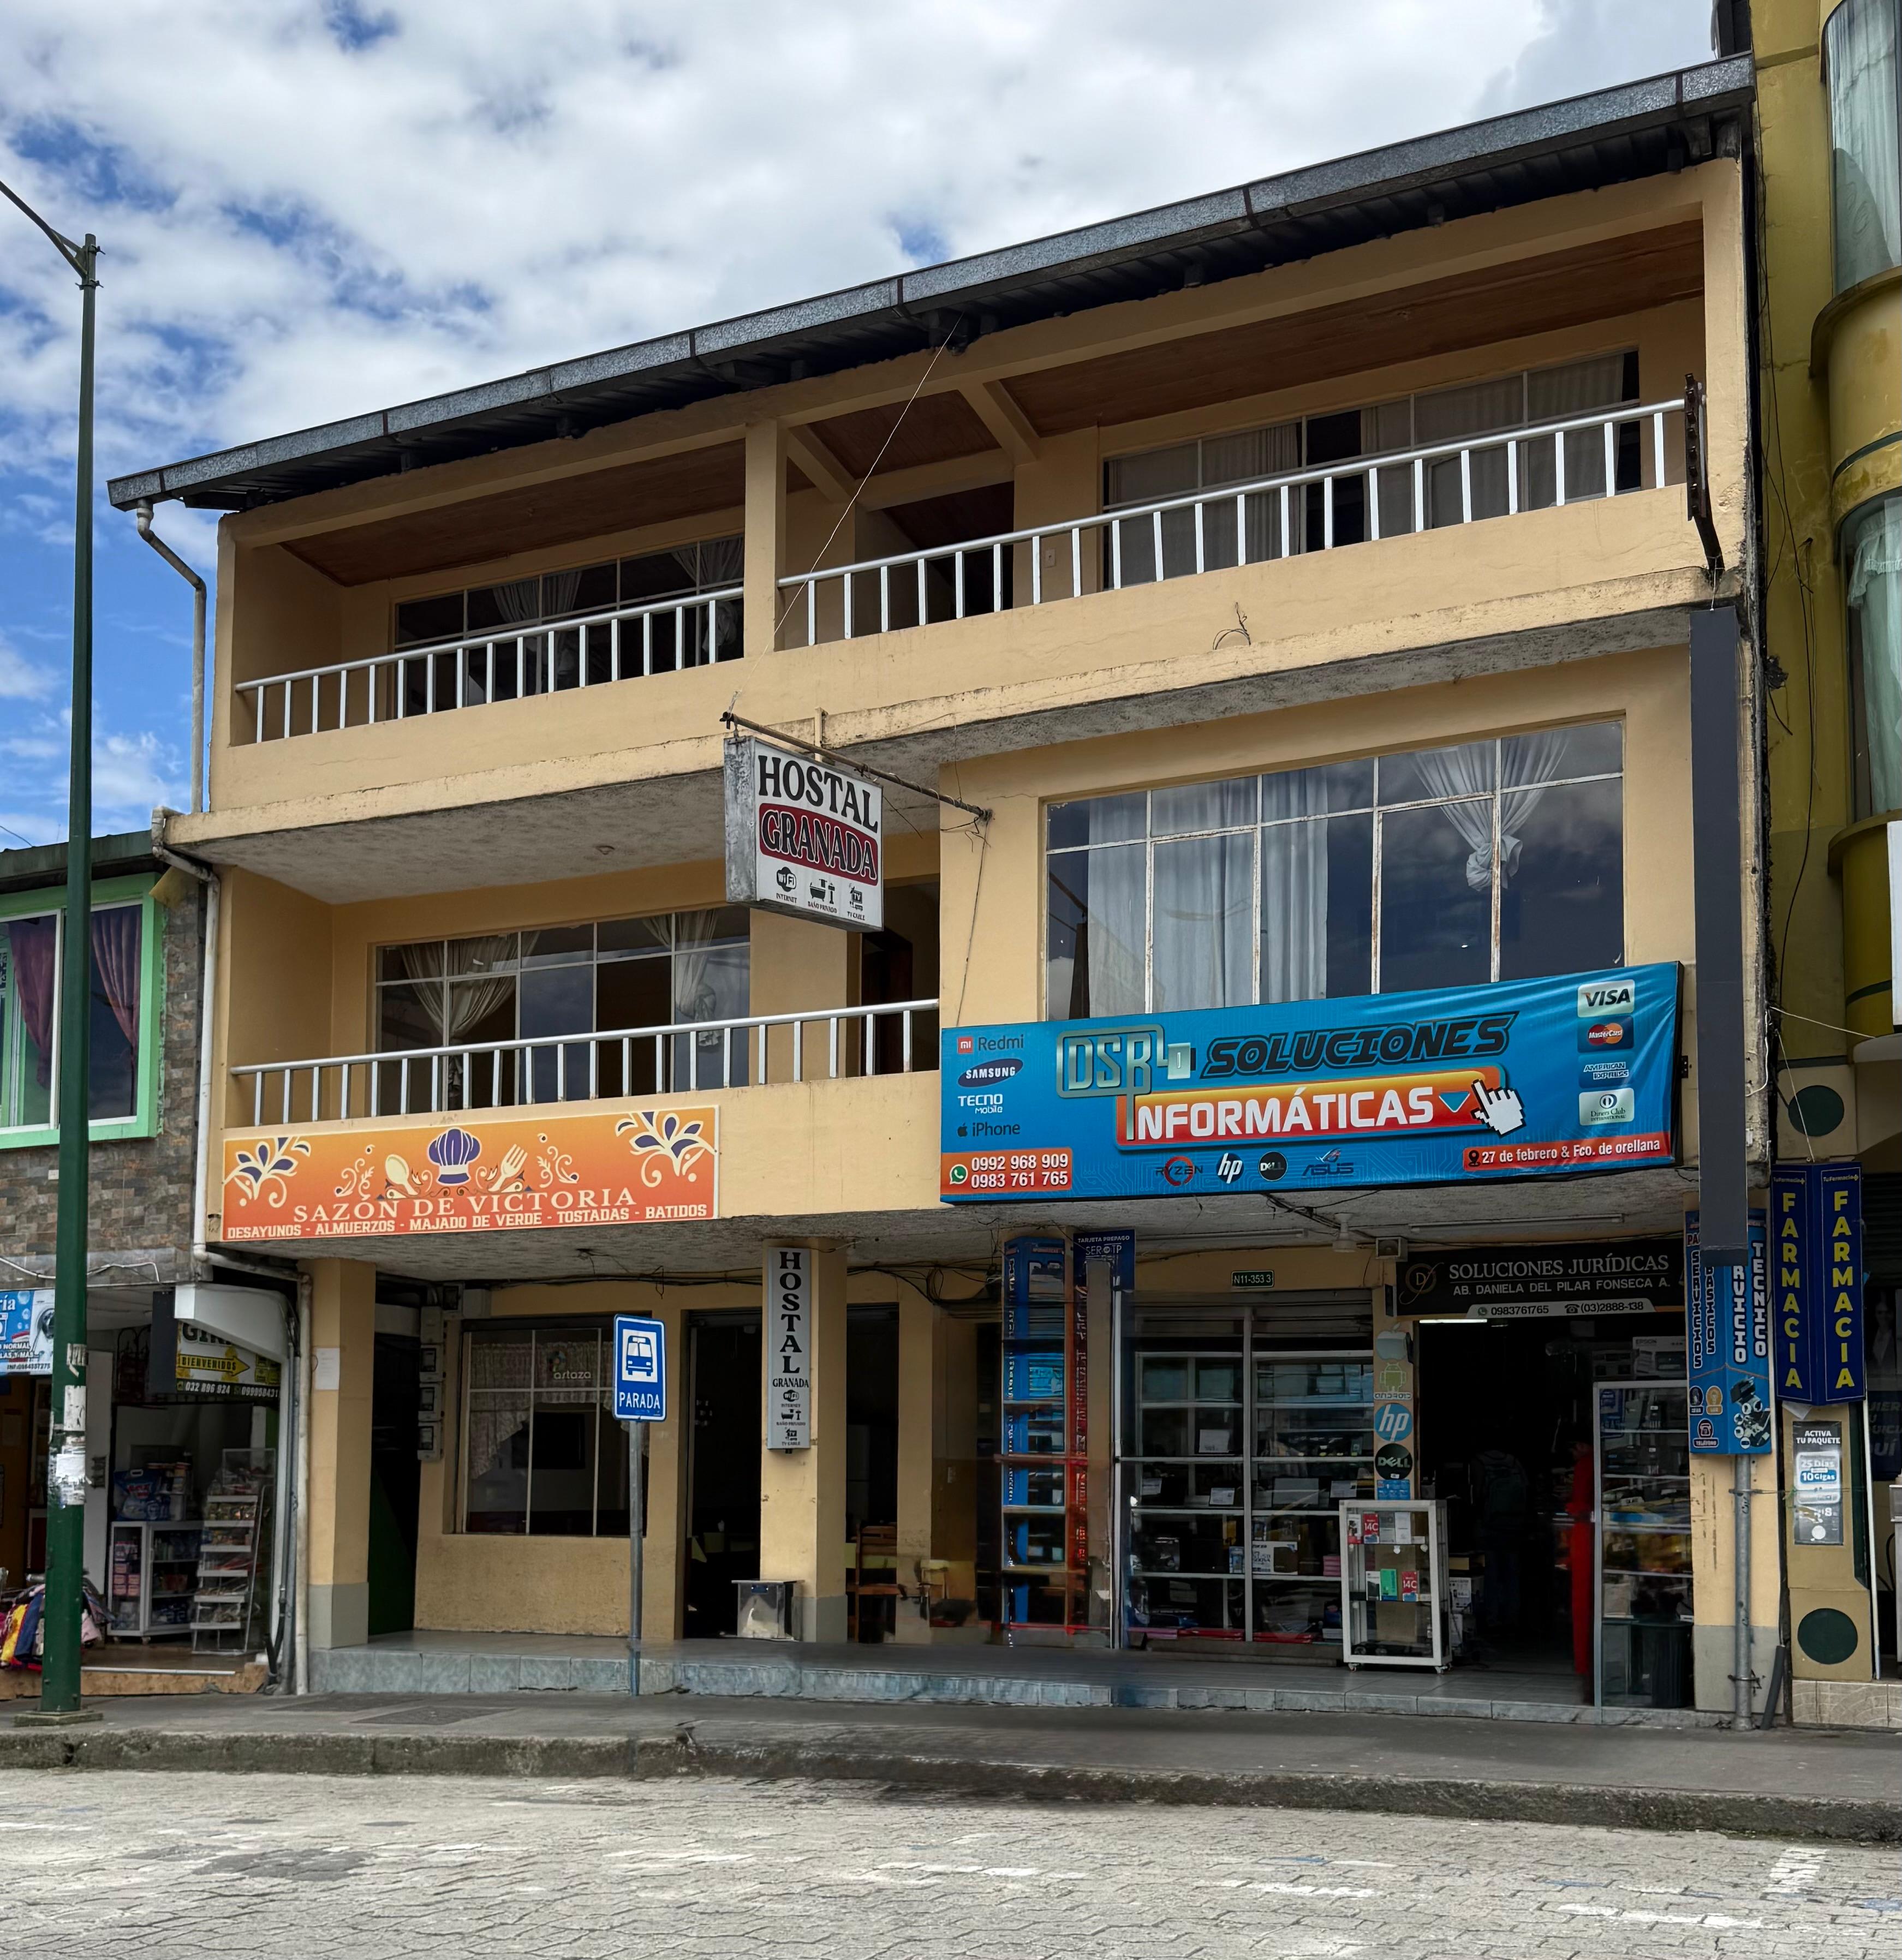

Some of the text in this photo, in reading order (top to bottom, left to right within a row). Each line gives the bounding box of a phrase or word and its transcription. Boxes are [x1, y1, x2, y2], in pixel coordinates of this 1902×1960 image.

[758, 755, 878, 834] HOSTAL
[761, 810, 878, 880] GRANADA
[1584, 988, 1631, 1007] VISA
[977, 1035, 1024, 1051] Redmi
[1588, 1027, 1624, 1041] MasterCard
[1202, 1011, 1518, 1078] SOLUCIONES
[965, 1066, 1016, 1079] SAMSUNG
[1584, 1061, 1626, 1073] AMERICAN
[958, 1093, 1003, 1107] TECNO
[972, 1122, 1021, 1137] iPhone
[1481, 1139, 1660, 1164] 27 de febrero & Fco. de orellana
[971, 1152, 1069, 1172] 0992 968 909
[1155, 1164, 1202, 1178] RYZEN
[1217, 1153, 1243, 1184] hp
[1260, 1161, 1284, 1172] DELL
[1302, 1161, 1355, 1179] ASUS
[971, 1170, 1069, 1189] 0983 761 765
[293, 1187, 637, 1223] SAZÓN DE VICTORIA
[227, 1224, 302, 1239] DESAYUNOS
[314, 1220, 396, 1236] ALMUERZOS
[409, 1216, 467, 1232] MAJADO
[472, 1215, 490, 1228] DE
[495, 1212, 542, 1227] VERDE
[556, 1208, 630, 1224] TOSTADAS
[645, 1204, 707, 1220] BATIDOS
[1449, 1253, 1670, 1281] SOLUCIONES JURÍDICAS
[1233, 1274, 1265, 1284] N11-353
[1453, 1277, 1671, 1296] AB. DANIELA DEL PILAR FONSECA A.
[1781, 1192, 1803, 1389] FARMACIA
[1832, 1190, 1855, 1389] FARMACIA
[1490, 1301, 1644, 1316] 0983761765 (03)2888-138
[1691, 1250, 1703, 1369] SERVICIOS
[1752, 1242, 1768, 1358] TECNICO
[779, 1251, 802, 1373] HOSTAL
[1732, 1266, 1748, 1364] RVICIO
[181, 1357, 236, 1371] BIENVENIDOS
[772, 1378, 809, 1388] GRANADA
[618, 1392, 661, 1409] PARADA
[1378, 1403, 1410, 1442] hp
[1807, 1437, 1841, 1445] PAQUETE
[1377, 1456, 1410, 1468] DELL
[1802, 1472, 1814, 1481] 10
